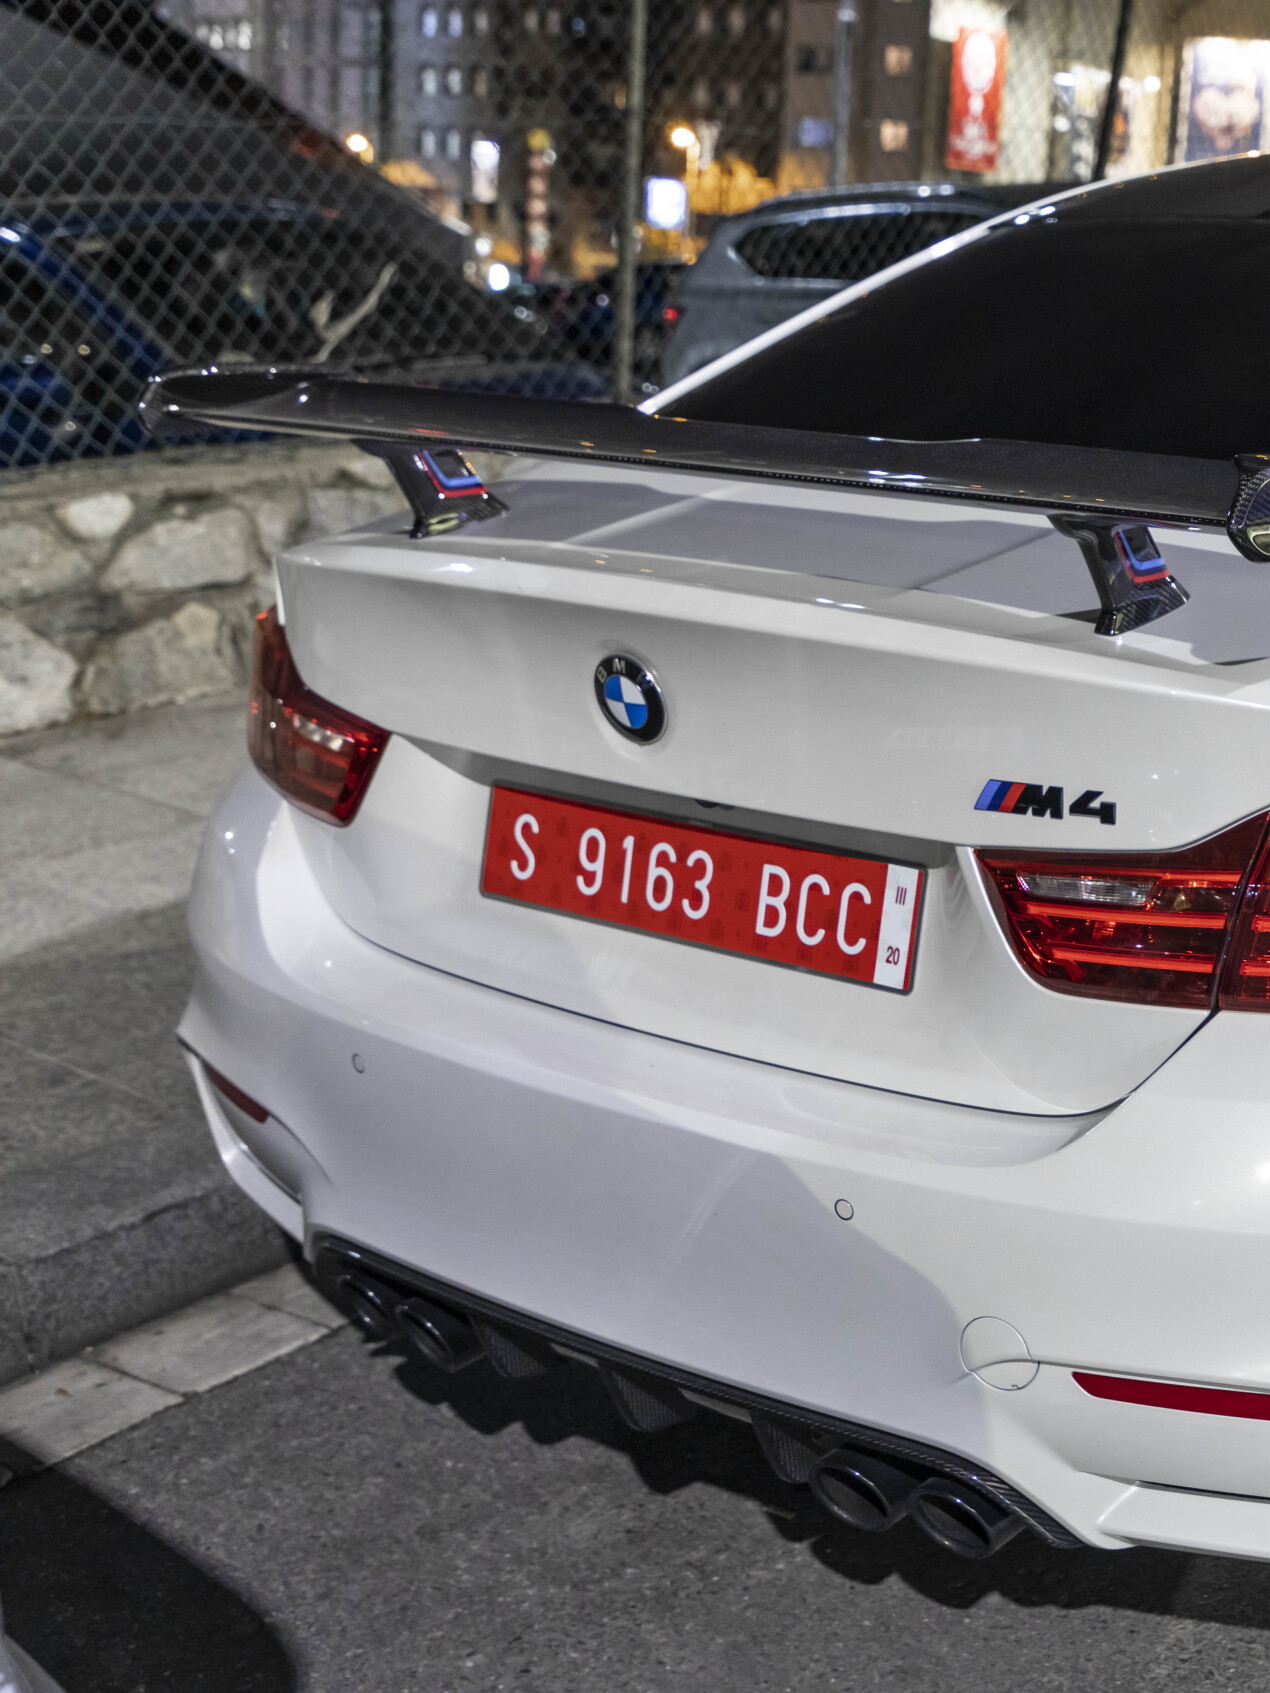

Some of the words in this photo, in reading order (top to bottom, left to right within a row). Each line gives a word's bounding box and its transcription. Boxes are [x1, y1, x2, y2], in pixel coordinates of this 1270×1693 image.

[510, 814, 539, 881] S
[576, 828, 714, 920] 9163
[755, 863, 872, 956] BCC
[885, 945, 901, 965] 20
